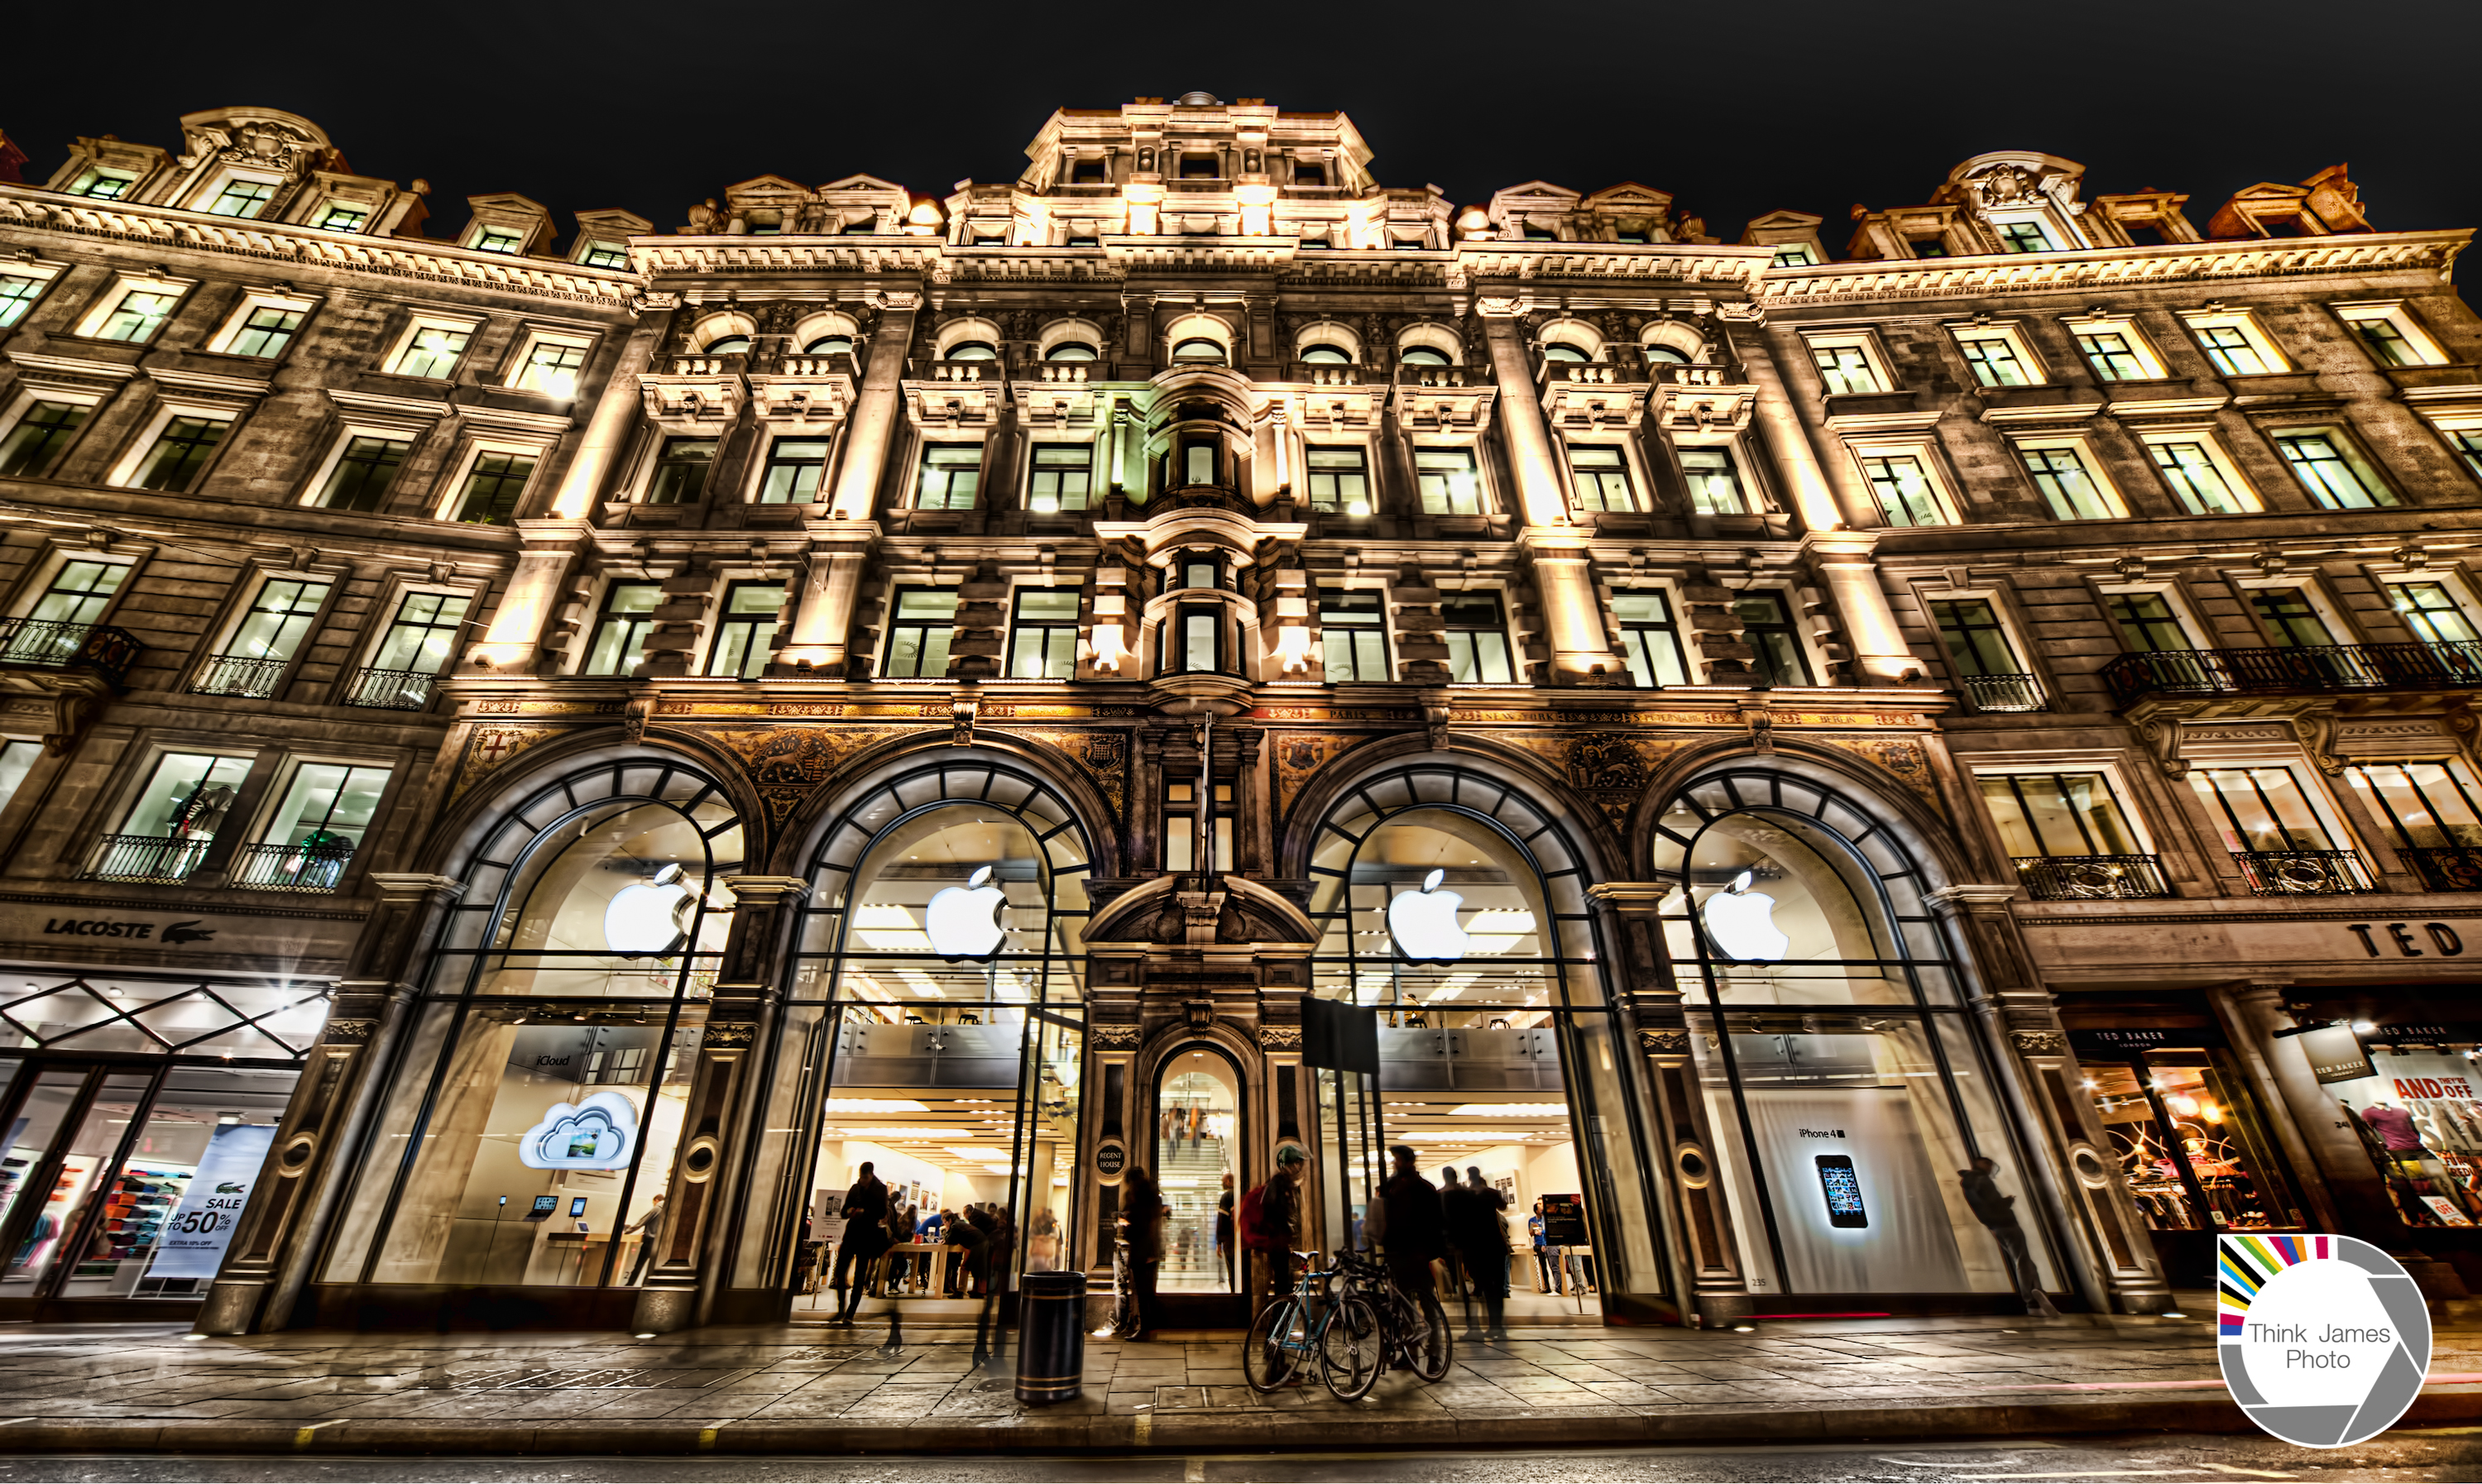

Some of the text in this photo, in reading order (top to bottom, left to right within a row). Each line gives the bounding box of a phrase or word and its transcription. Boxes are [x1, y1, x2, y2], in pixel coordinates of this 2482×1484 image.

[1330, 710, 1366, 719] PARIS
[1484, 712, 1515, 720] NEW
[1820, 716, 1857, 724] BERLIN
[44, 918, 155, 939] LACOSTE
[2346, 922, 2463, 957] TED
[2375, 1026, 2446, 1035] TED BAKER
[2096, 1032, 2165, 1041] TED BAKER
[536, 1055, 571, 1065] iCloud
[2316, 1060, 2365, 1075] TED BAKER
[2393, 1078, 2444, 1099] AND
[2443, 1084, 2473, 1099] OFF
[2401, 1100, 2431, 1118] TO
[1799, 1128, 1829, 1138] iPhone
[205, 1198, 242, 1209] SALE
[170, 1213, 185, 1222] UP
[167, 1222, 182, 1231] TO
[1751, 1278, 1766, 1286] 235
